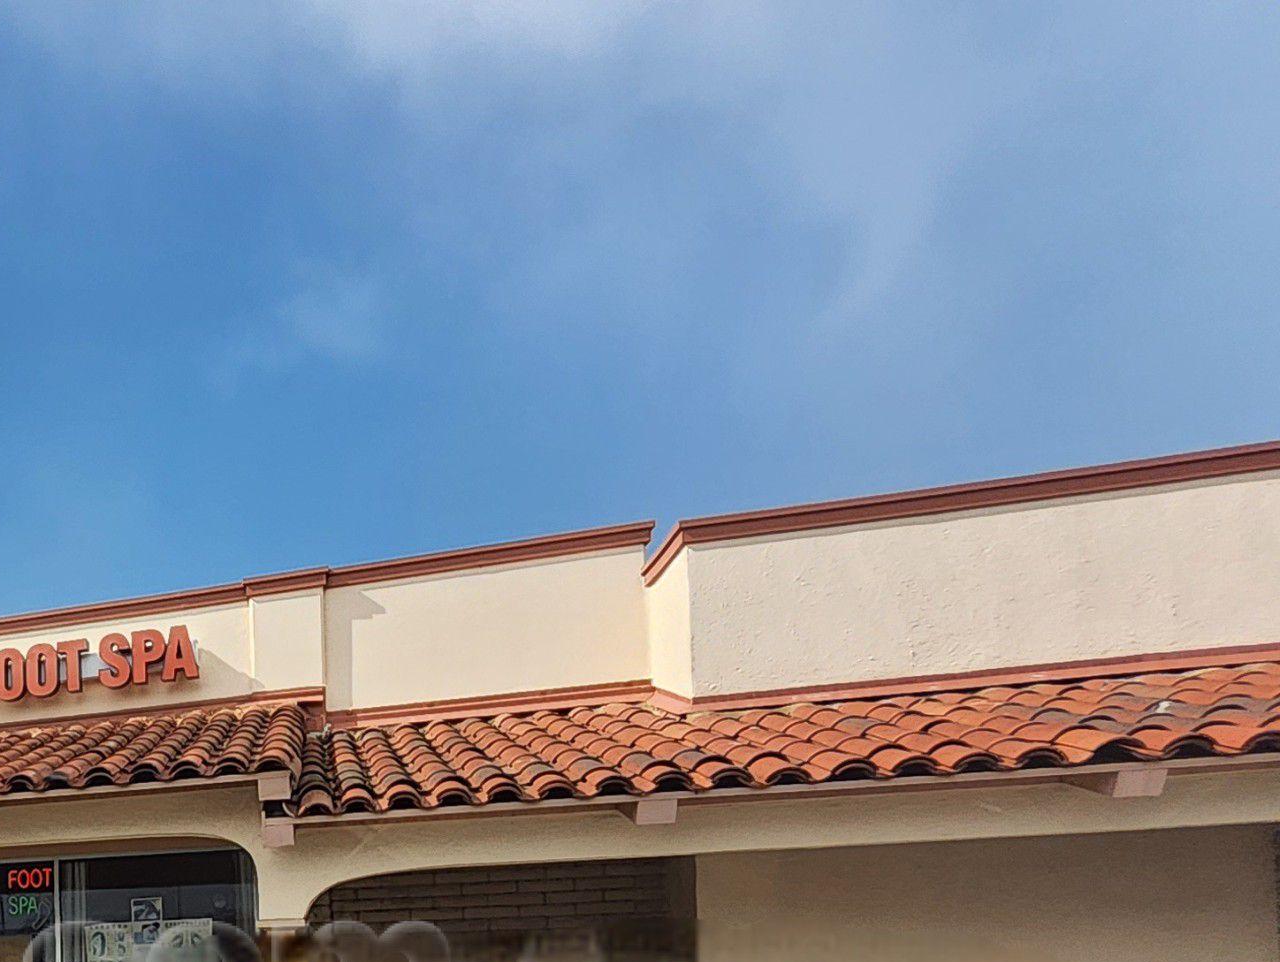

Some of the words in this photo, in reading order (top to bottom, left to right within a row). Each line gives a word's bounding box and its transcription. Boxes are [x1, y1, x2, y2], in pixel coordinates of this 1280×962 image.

[98, 625, 200, 688] SPA
[7, 867, 52, 889] FOOT
[7, 895, 38, 915] SPA
